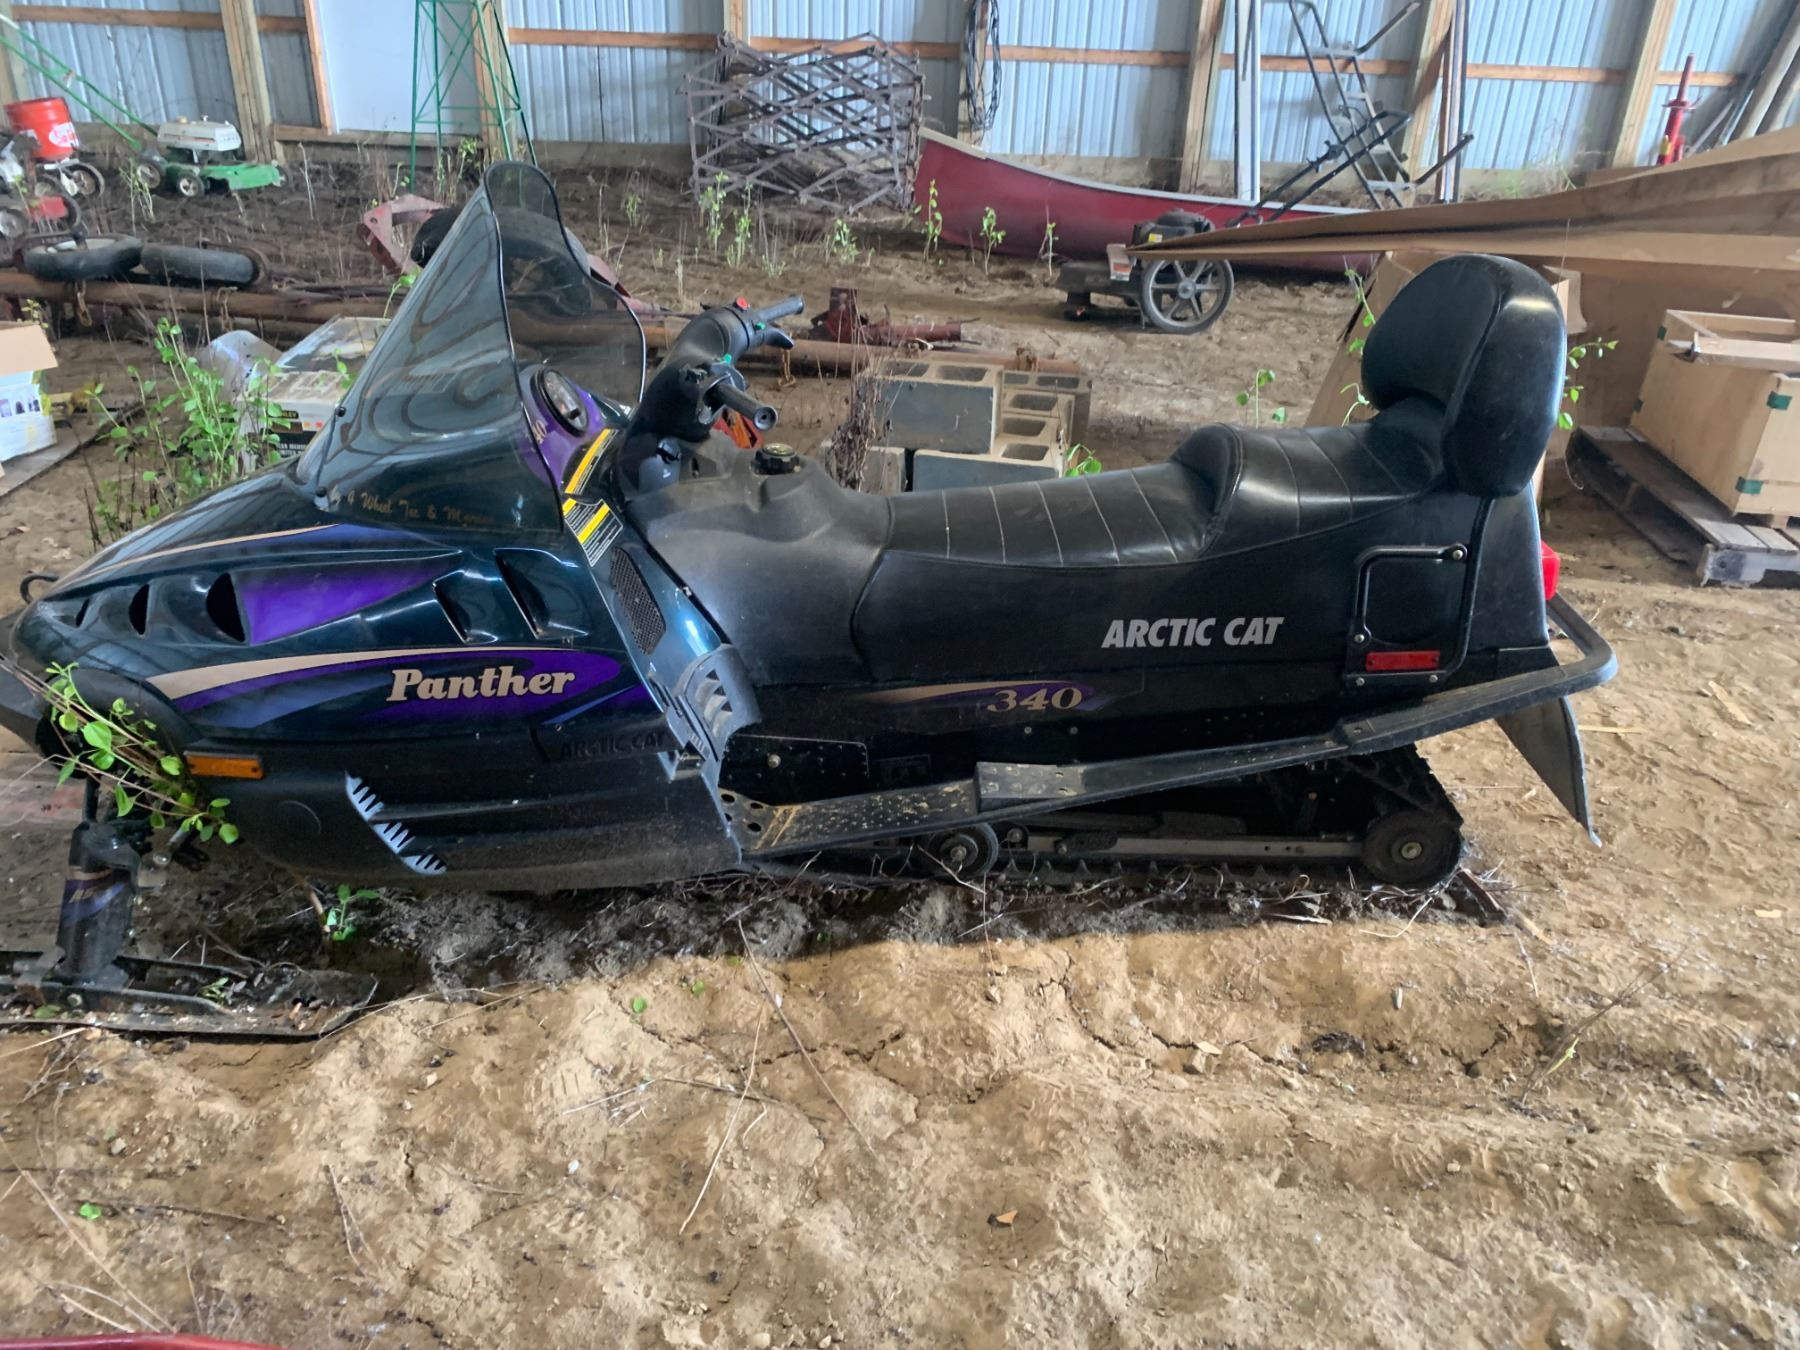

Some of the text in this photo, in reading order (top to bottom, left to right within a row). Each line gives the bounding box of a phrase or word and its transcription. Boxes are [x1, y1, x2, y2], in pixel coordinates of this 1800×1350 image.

[1100, 616, 1285, 649] ARCTIC CAT
[386, 665, 576, 702] Panther
[987, 686, 1083, 713] 340
